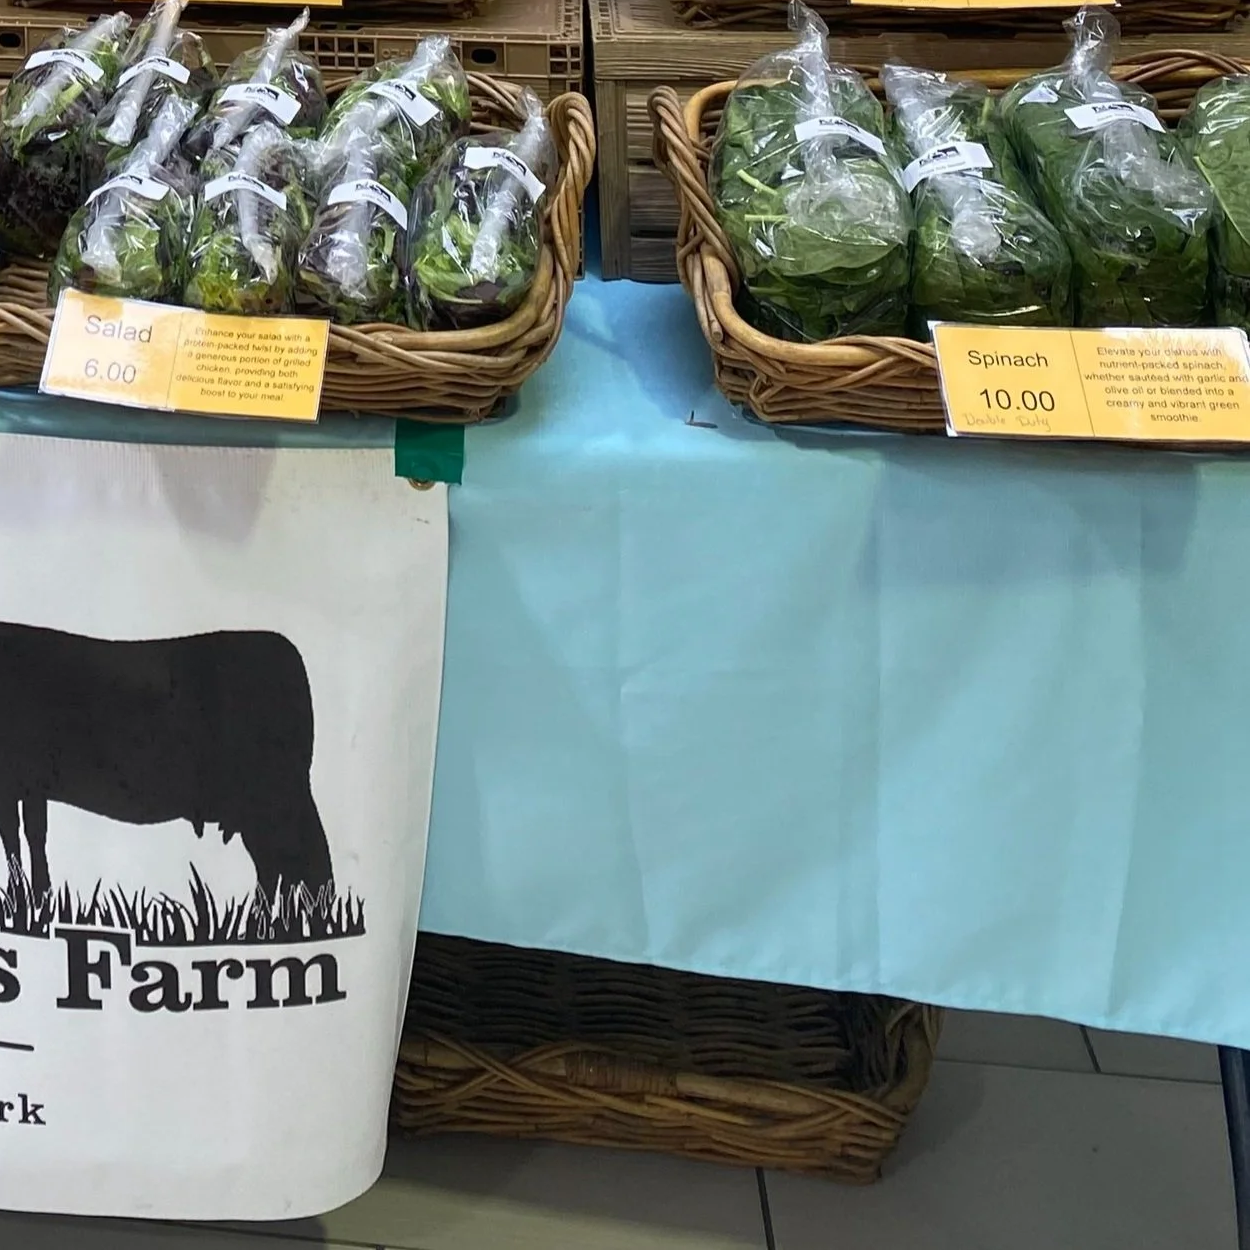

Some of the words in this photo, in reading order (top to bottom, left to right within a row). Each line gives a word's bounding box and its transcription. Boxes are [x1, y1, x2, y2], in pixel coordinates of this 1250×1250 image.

[84, 314, 153, 343] Salad
[184, 339, 250, 352] protein-packed
[252, 344, 272, 353] twist
[274, 345, 285, 355] by
[287, 346, 318, 356] adding
[968, 350, 1048, 370] Spinach
[1100, 360, 1179, 371] nutrient-packed
[84, 358, 136, 384] 6.00
[235, 366, 276, 378] providing
[278, 369, 298, 378] both
[979, 388, 1055, 412] 10.00
[1106, 400, 1144, 410] creamy
[1148, 399, 1167, 408] and
[1171, 399, 1207, 409] vibrant
[1209, 402, 1240, 411] green
[1019, 415, 1051, 431] Duty
[55, 926, 348, 1014] Farm
